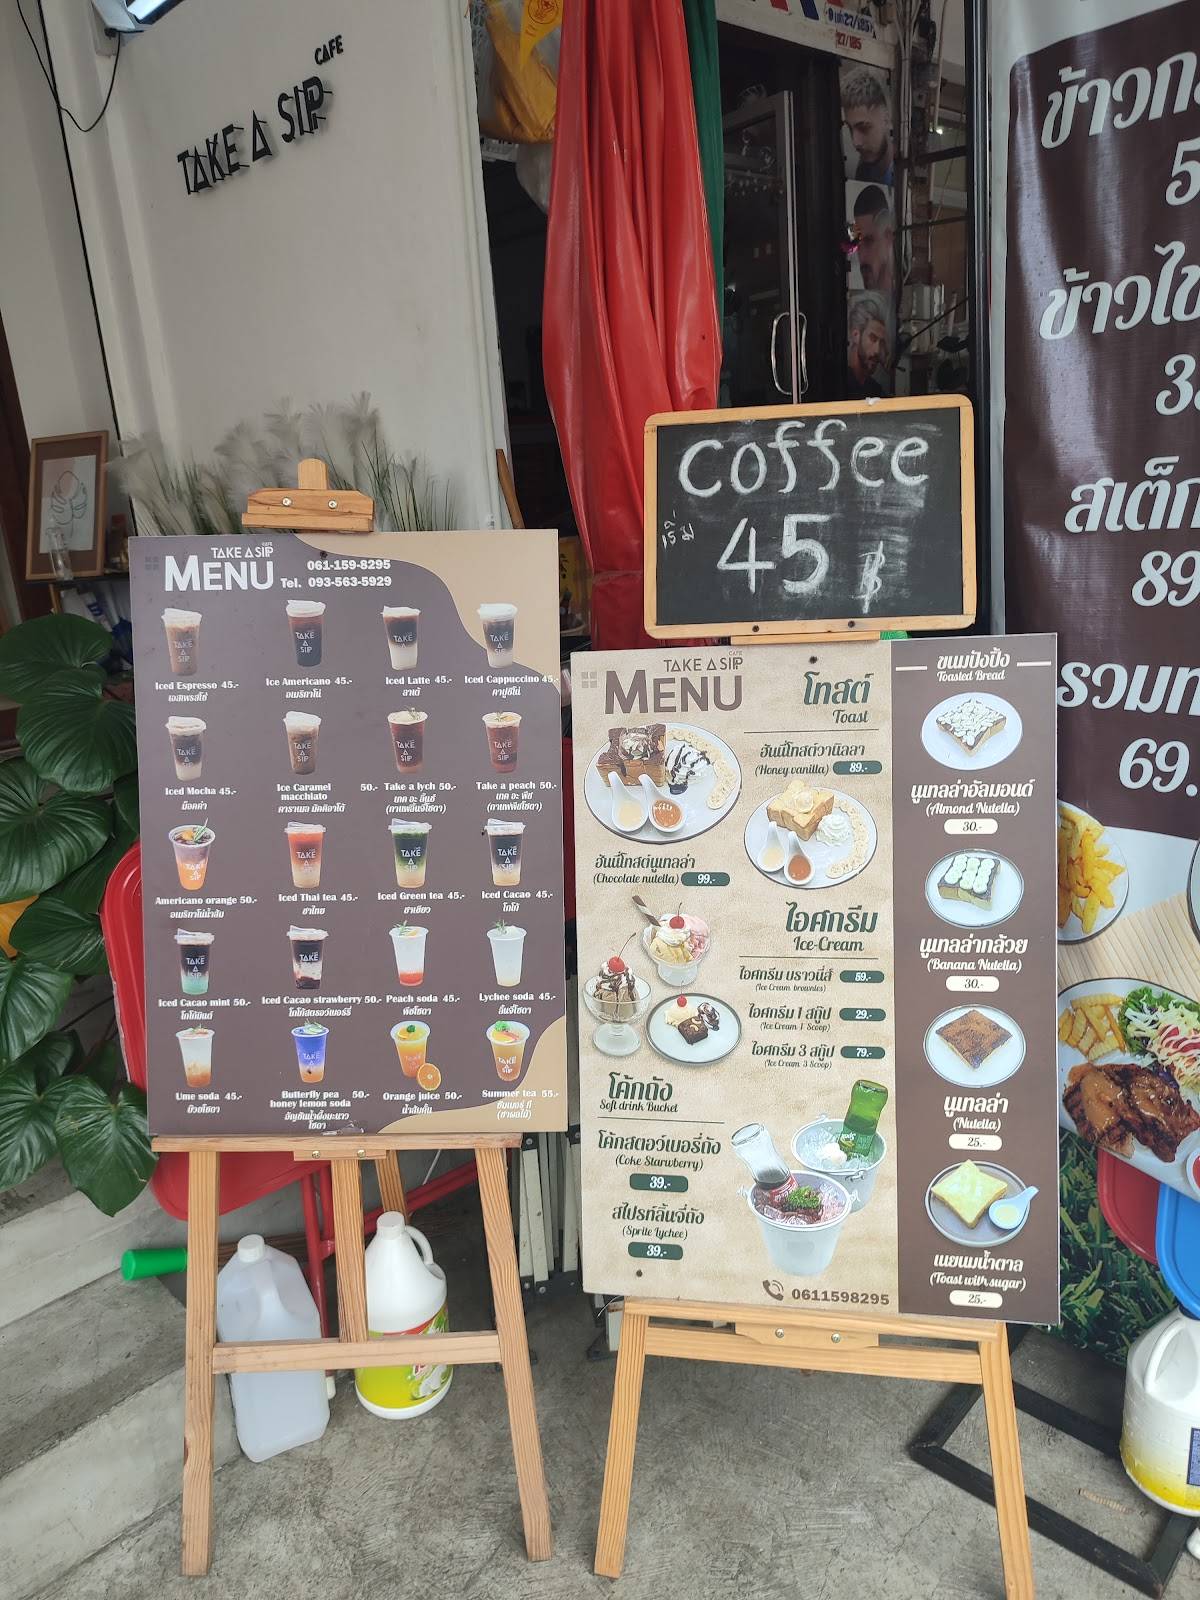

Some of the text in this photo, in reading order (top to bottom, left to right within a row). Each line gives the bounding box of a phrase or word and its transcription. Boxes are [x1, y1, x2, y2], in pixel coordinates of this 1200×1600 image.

[315, 35, 343, 65] CAFE
[1041, 52, 1200, 149] ข้าวก
[177, 76, 324, 195] TAKE A SIP
[1155, 353, 1200, 416] 3
[211, 547, 241, 559] TAKE
[254, 546, 273, 558] SIP
[716, 514, 832, 593] 45
[307, 559, 391, 571] 061-159-8295
[165, 555, 273, 591] MENU
[281, 576, 392, 588] Tel. 093-563-5929
[664, 657, 743, 672] TAKE A SIP
[266, 678, 280, 686] Ice
[282, 677, 330, 686] Americano
[386, 677, 404, 685] Iced
[408, 676, 430, 684] Latte
[464, 675, 559, 685] Iced Cappuccino 45.-
[937, 670, 1005, 682] Toasted Bread
[155, 681, 239, 691] Iced Espresso 45.-
[605, 670, 742, 714] MENU
[804, 671, 874, 705] โทสต์
[833, 710, 869, 723] Toast
[755, 763, 867, 777] (Honey vanilla) 89.-
[187, 787, 216, 795] Mocha
[219, 787, 237, 795] 45.-
[293, 783, 331, 791] Caramel
[360, 783, 378, 791] 50.-
[417, 783, 435, 792] lych
[509, 782, 535, 791] peach
[281, 793, 327, 801] macchiato
[925, 802, 1020, 817] (Almond Nutella)
[963, 822, 981, 832] 30.-
[593, 873, 715, 885] (Chocolate nutella) 99.-
[279, 894, 297, 902] Iced
[300, 893, 320, 901] Thai
[340, 894, 358, 902] 45.-
[400, 892, 426, 900] Green
[482, 890, 553, 899] Iced Cacao 45.-
[155, 896, 257, 906] Americano orange 50.-
[786, 902, 878, 933] ไอศกรีม
[927, 958, 1022, 974] (Banana Nutella)
[739, 966, 783, 981] ไอศกรีม
[964, 979, 984, 989] 30.-
[158, 999, 177, 1007] Iced
[180, 999, 207, 1007] Cacao
[262, 996, 382, 1004] Iced Cacao strawberry 50.-
[386, 995, 460, 1003] Peach soda 45.-
[479, 993, 509, 1002] Lychee
[513, 993, 534, 1001] soda
[749, 1003, 794, 1019] ไอศกรีม
[855, 1010, 872, 1019] 29.-
[752, 1041, 795, 1056] ไอศกรีม
[799, 1044, 806, 1057] 3
[856, 1048, 872, 1057] 79.-
[608, 1072, 673, 1101] โค้กถัง
[176, 1092, 242, 1100] Ume soda 45.-
[282, 1091, 320, 1099] Butterfly
[383, 1092, 462, 1102] Orange juice 50.-
[482, 1090, 520, 1098] Summer
[270, 1099, 351, 1109] honey lemon soda
[600, 1100, 678, 1112] Soft drink Bucket
[944, 1092, 1008, 1117] นูเทลล่า
[953, 1117, 1001, 1132] (Nutella)
[968, 1137, 986, 1147] 25.-
[615, 1155, 704, 1172] (Coke Starwberry)
[650, 1176, 671, 1189] 39.-
[622, 1225, 688, 1240] (Sprite Lychee)
[647, 1245, 667, 1256] 39.-
[930, 1272, 1027, 1292] (Toast with sugar)
[792, 1288, 890, 1306] 0611598295
[968, 1294, 986, 1304] 25.-
